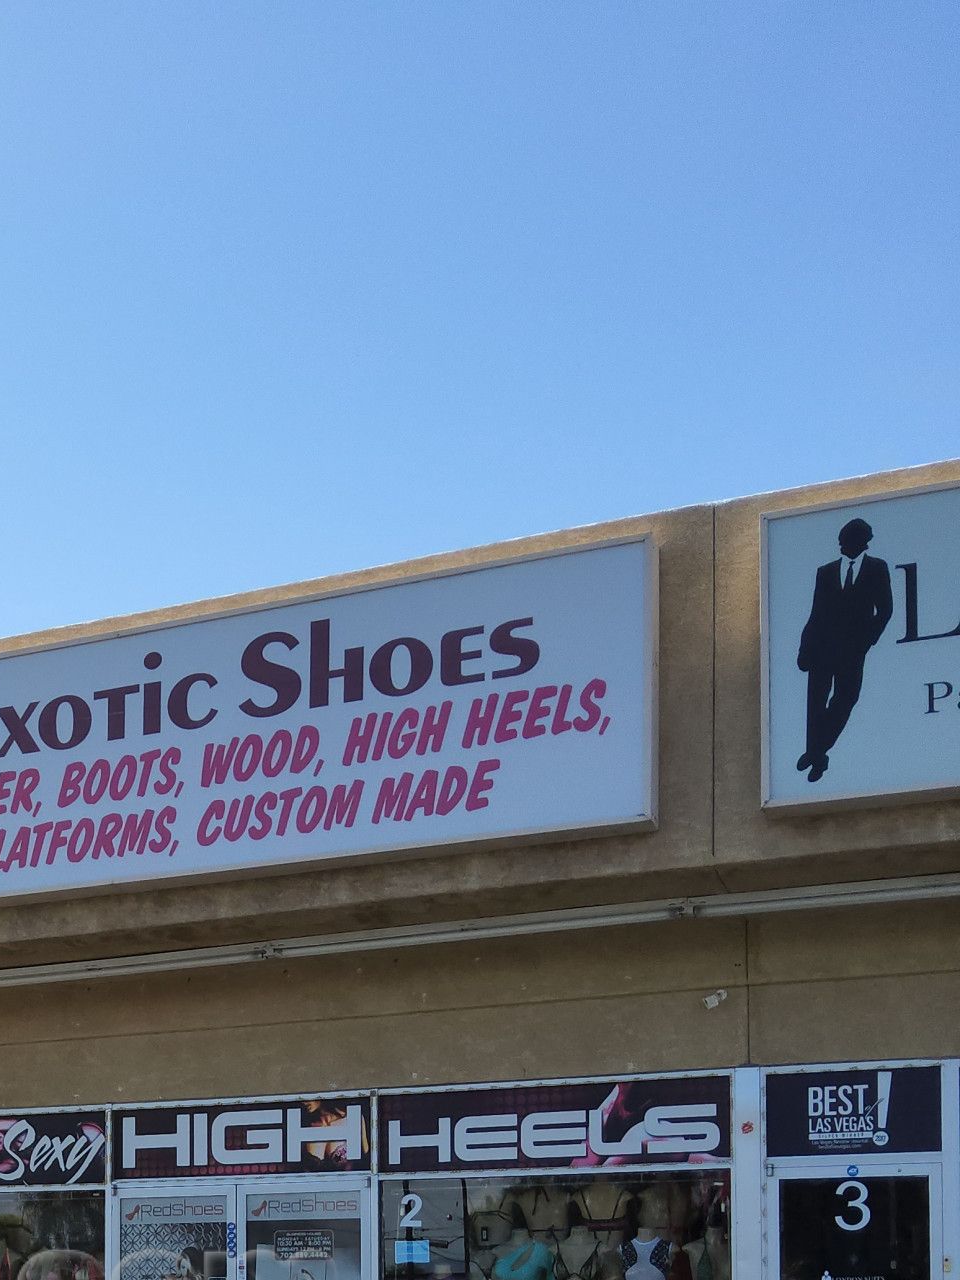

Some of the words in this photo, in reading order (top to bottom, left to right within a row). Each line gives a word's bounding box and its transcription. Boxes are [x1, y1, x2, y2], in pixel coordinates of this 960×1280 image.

[57, 746, 185, 809] BOOTS,
[201, 725, 325, 786] WOOD,
[342, 702, 443, 765] HIGH
[462, 678, 612, 747] HEELS,
[196, 778, 365, 848] CUSTOM
[372, 758, 502, 823] MADE
[808, 1084, 869, 1116] BEST
[808, 1117, 831, 1133] LAS
[834, 1116, 874, 1132] VEGAS
[122, 1105, 362, 1169] HIGH
[388, 1084, 722, 1165] HEELS
[400, 1194, 423, 1228] 2
[835, 1180, 871, 1231] 3
